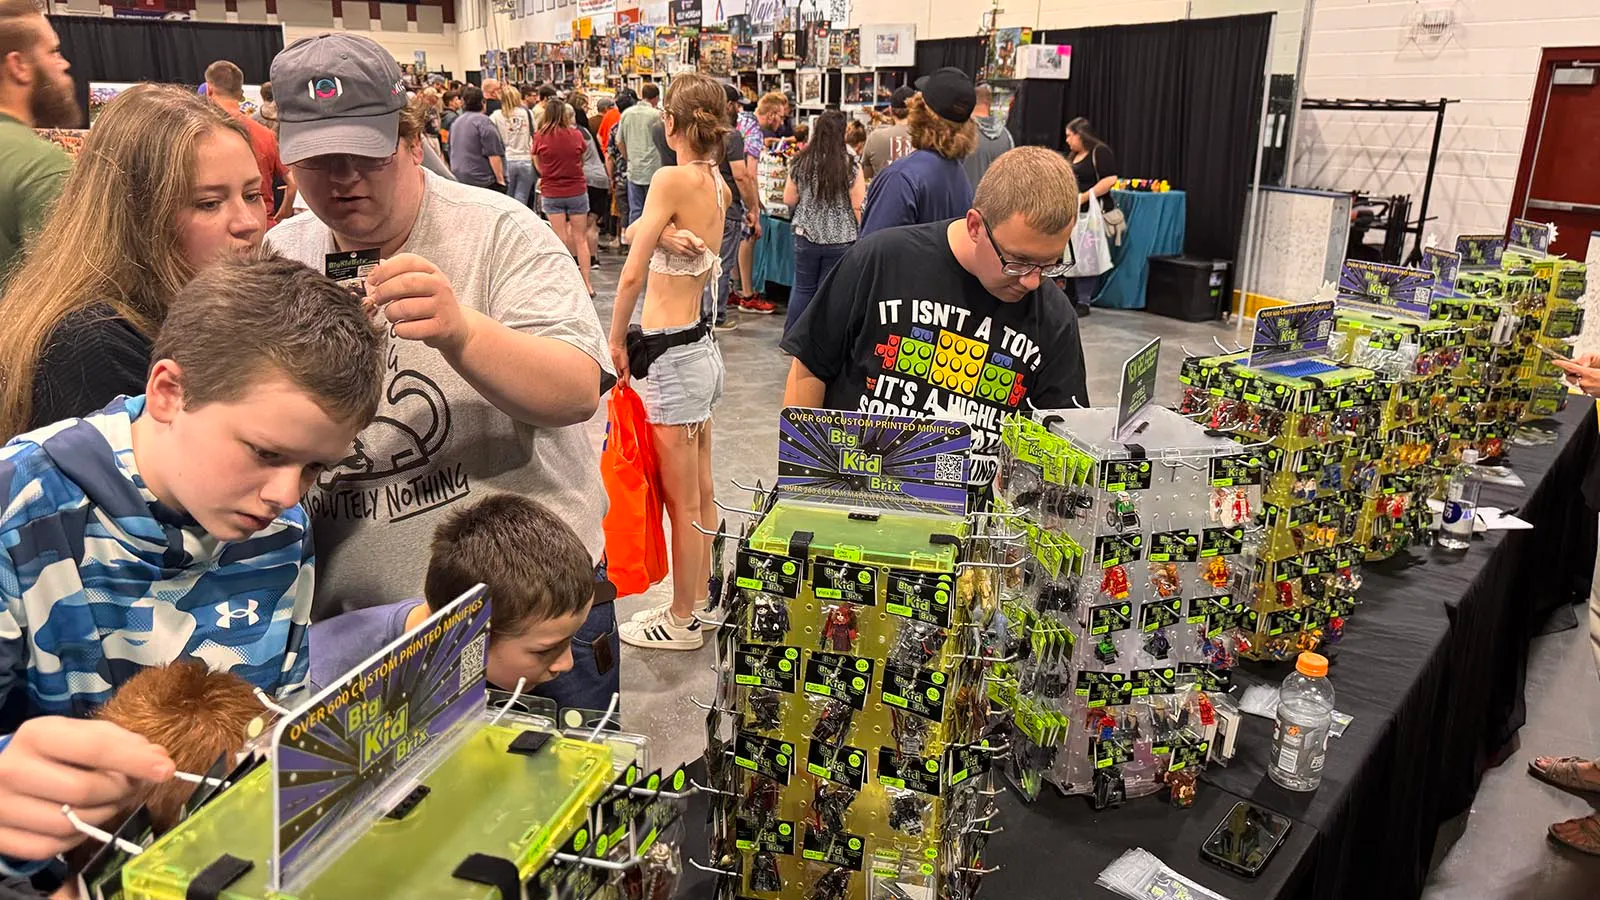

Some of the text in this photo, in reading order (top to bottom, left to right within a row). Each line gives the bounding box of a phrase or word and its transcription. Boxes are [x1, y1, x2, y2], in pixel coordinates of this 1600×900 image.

[1369, 284, 1388, 296] Kid
[878, 299, 902, 325] IT
[912, 299, 971, 332] ISN'T
[974, 316, 992, 342] A
[1280, 329, 1297, 342] Kid
[873, 374, 918, 406] IT'S
[789, 412, 961, 436] OVER 600 CUSTOM PRINTED MINIFIGS
[830, 428, 857, 448] Big
[842, 453, 879, 474] Kid
[1120, 472, 1137, 482] Kid
[1228, 468, 1246, 477] Kid
[385, 463, 471, 517] NOTHING
[870, 476, 901, 492] Brix
[1165, 544, 1183, 554] Kid
[756, 568, 778, 582] Kid
[834, 578, 855, 591] Kid
[898, 581, 913, 593] Big
[906, 594, 929, 611] Kid
[1202, 605, 1218, 615] Kid
[290, 598, 484, 741] OVER 600 CUSTOM PRINTED MINIFIGS
[754, 667, 775, 679] Kid
[825, 677, 846, 691] Kid
[1143, 678, 1161, 687] Kid
[902, 687, 922, 703] Kid
[348, 699, 380, 729] Big
[363, 709, 408, 763] Kid
[396, 729, 429, 762] Brix
